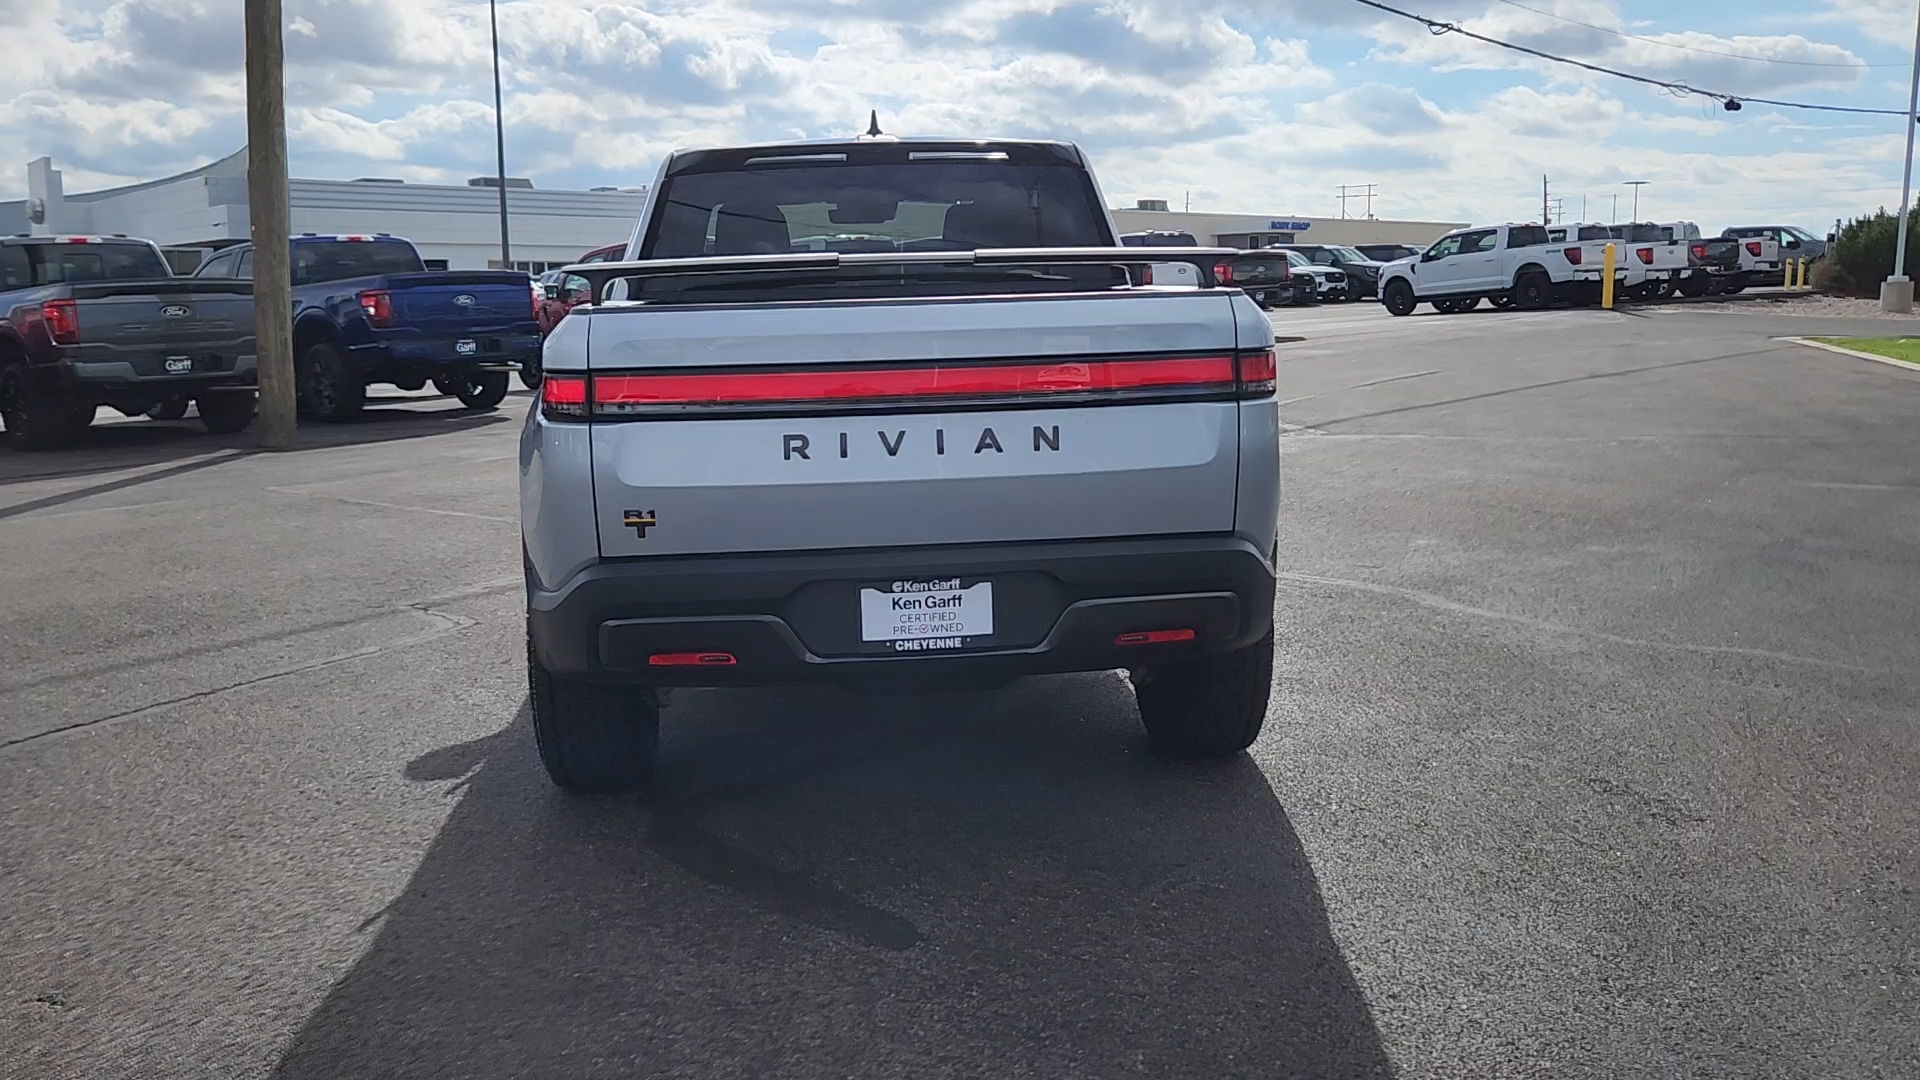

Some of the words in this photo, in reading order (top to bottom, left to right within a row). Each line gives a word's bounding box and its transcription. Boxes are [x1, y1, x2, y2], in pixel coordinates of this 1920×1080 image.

[165, 359, 192, 371] Garff
[783, 425, 1060, 461] RIVIAN
[904, 581, 928, 592] Ken
[929, 578, 961, 591] Garff
[892, 596, 921, 610] Ken
[924, 594, 963, 609] Garff
[899, 611, 957, 623] CERTIFIED
[895, 637, 962, 651] CHEYENNE
